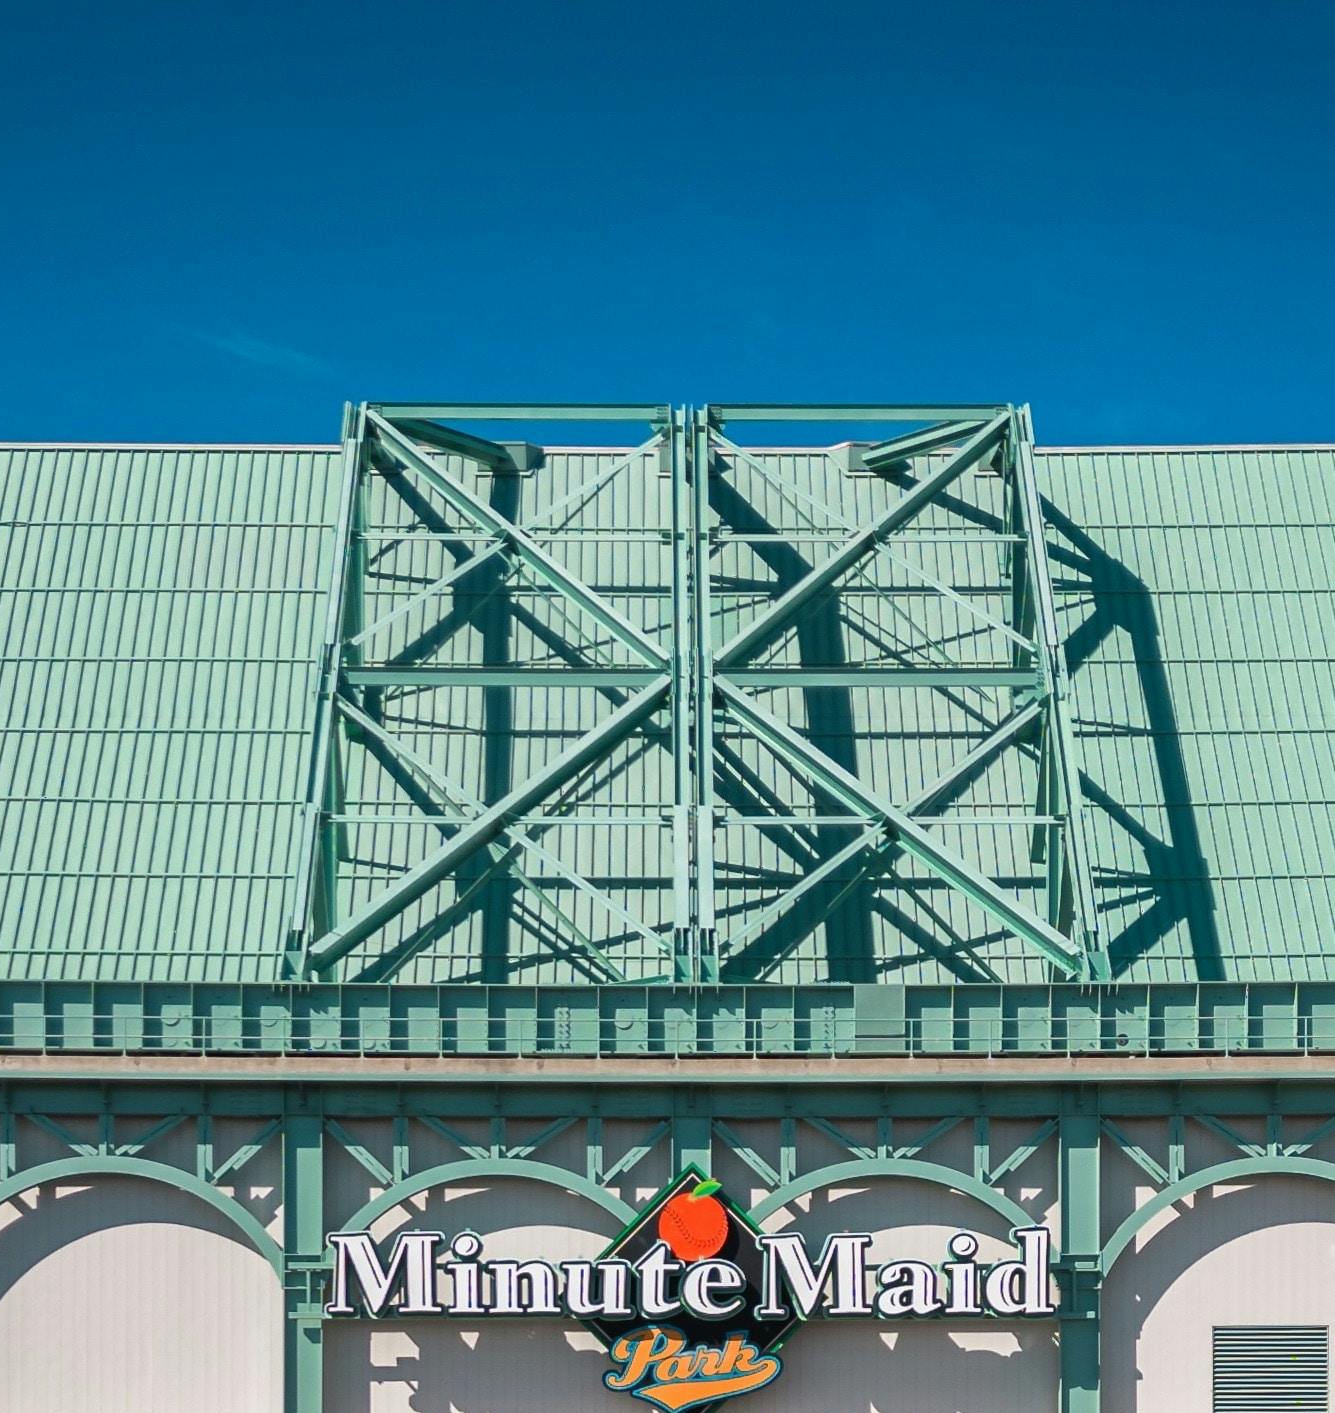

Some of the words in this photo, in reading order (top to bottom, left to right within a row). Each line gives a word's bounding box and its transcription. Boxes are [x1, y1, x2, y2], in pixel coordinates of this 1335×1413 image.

[325, 1228, 747, 1320] Minute
[755, 1224, 1056, 1319] Maid
[604, 1325, 780, 1402] Park
